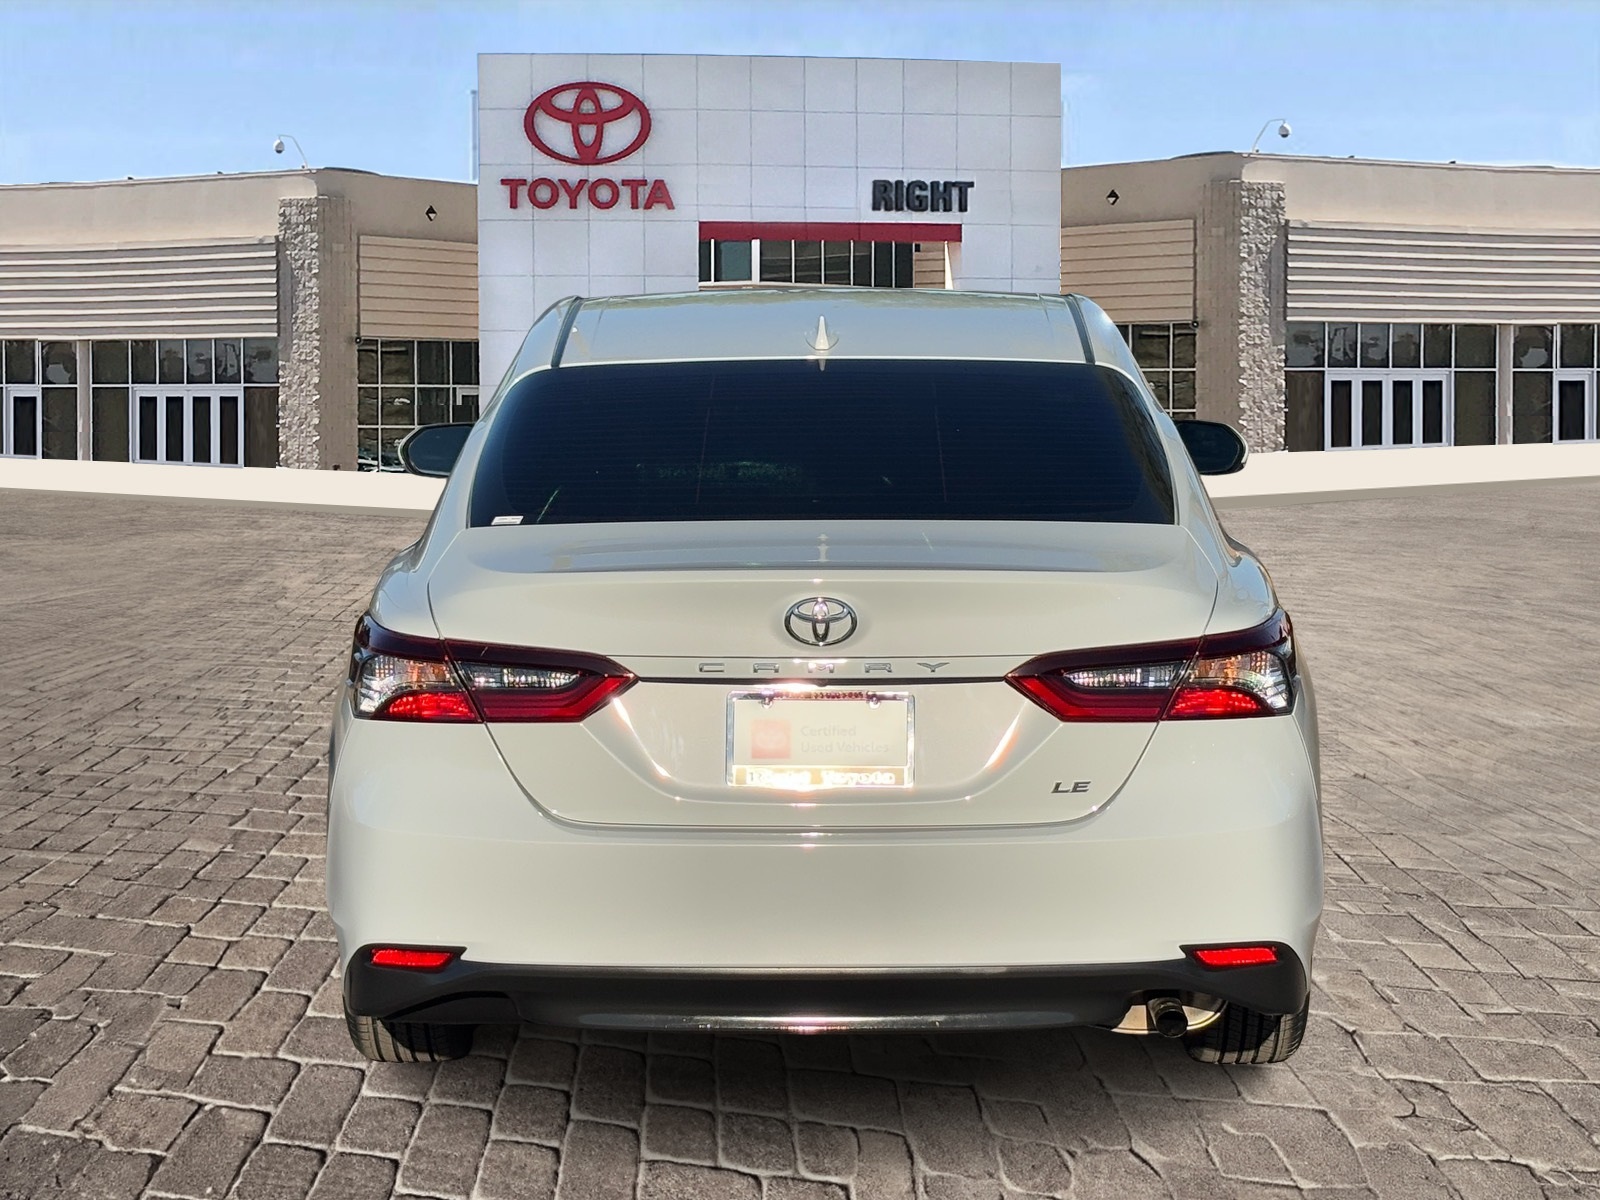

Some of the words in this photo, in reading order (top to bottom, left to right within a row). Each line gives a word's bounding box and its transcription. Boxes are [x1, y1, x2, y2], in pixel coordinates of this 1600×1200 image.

[500, 178, 675, 211] TOYOTA
[871, 179, 975, 213] RIGHT
[699, 661, 950, 674] CAMRY
[800, 725, 857, 737] Certified
[801, 741, 834, 753] Used
[837, 741, 890, 753] Vehicles
[1051, 780, 1092, 794] LE
